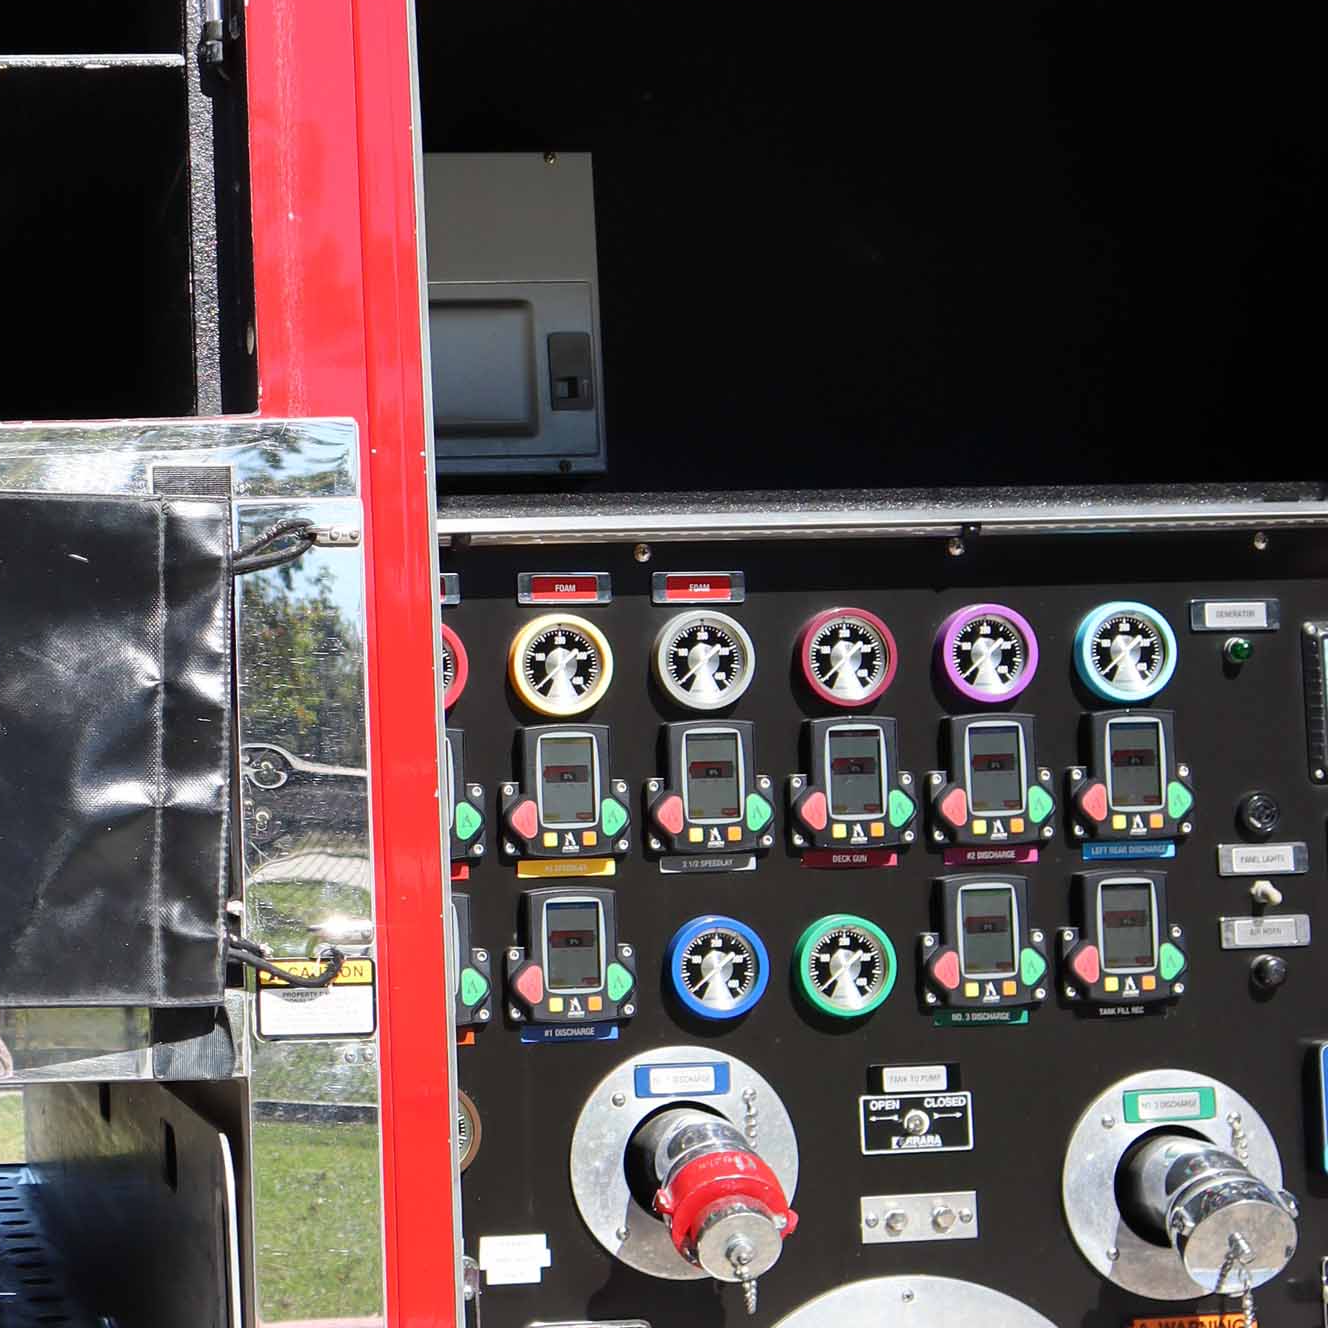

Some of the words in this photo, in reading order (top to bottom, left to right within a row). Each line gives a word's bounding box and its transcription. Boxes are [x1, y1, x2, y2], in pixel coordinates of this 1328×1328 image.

[555, 584, 576, 592] FOAM
[689, 583, 710, 592] FOAM
[832, 855, 851, 863] DECK
[853, 855, 867, 863] GUN
[544, 1029, 553, 1037] #1
[555, 1027, 595, 1036] DISCHARGE
[869, 1100, 900, 1111] OPEN
[924, 1096, 967, 1108] CLOSED
